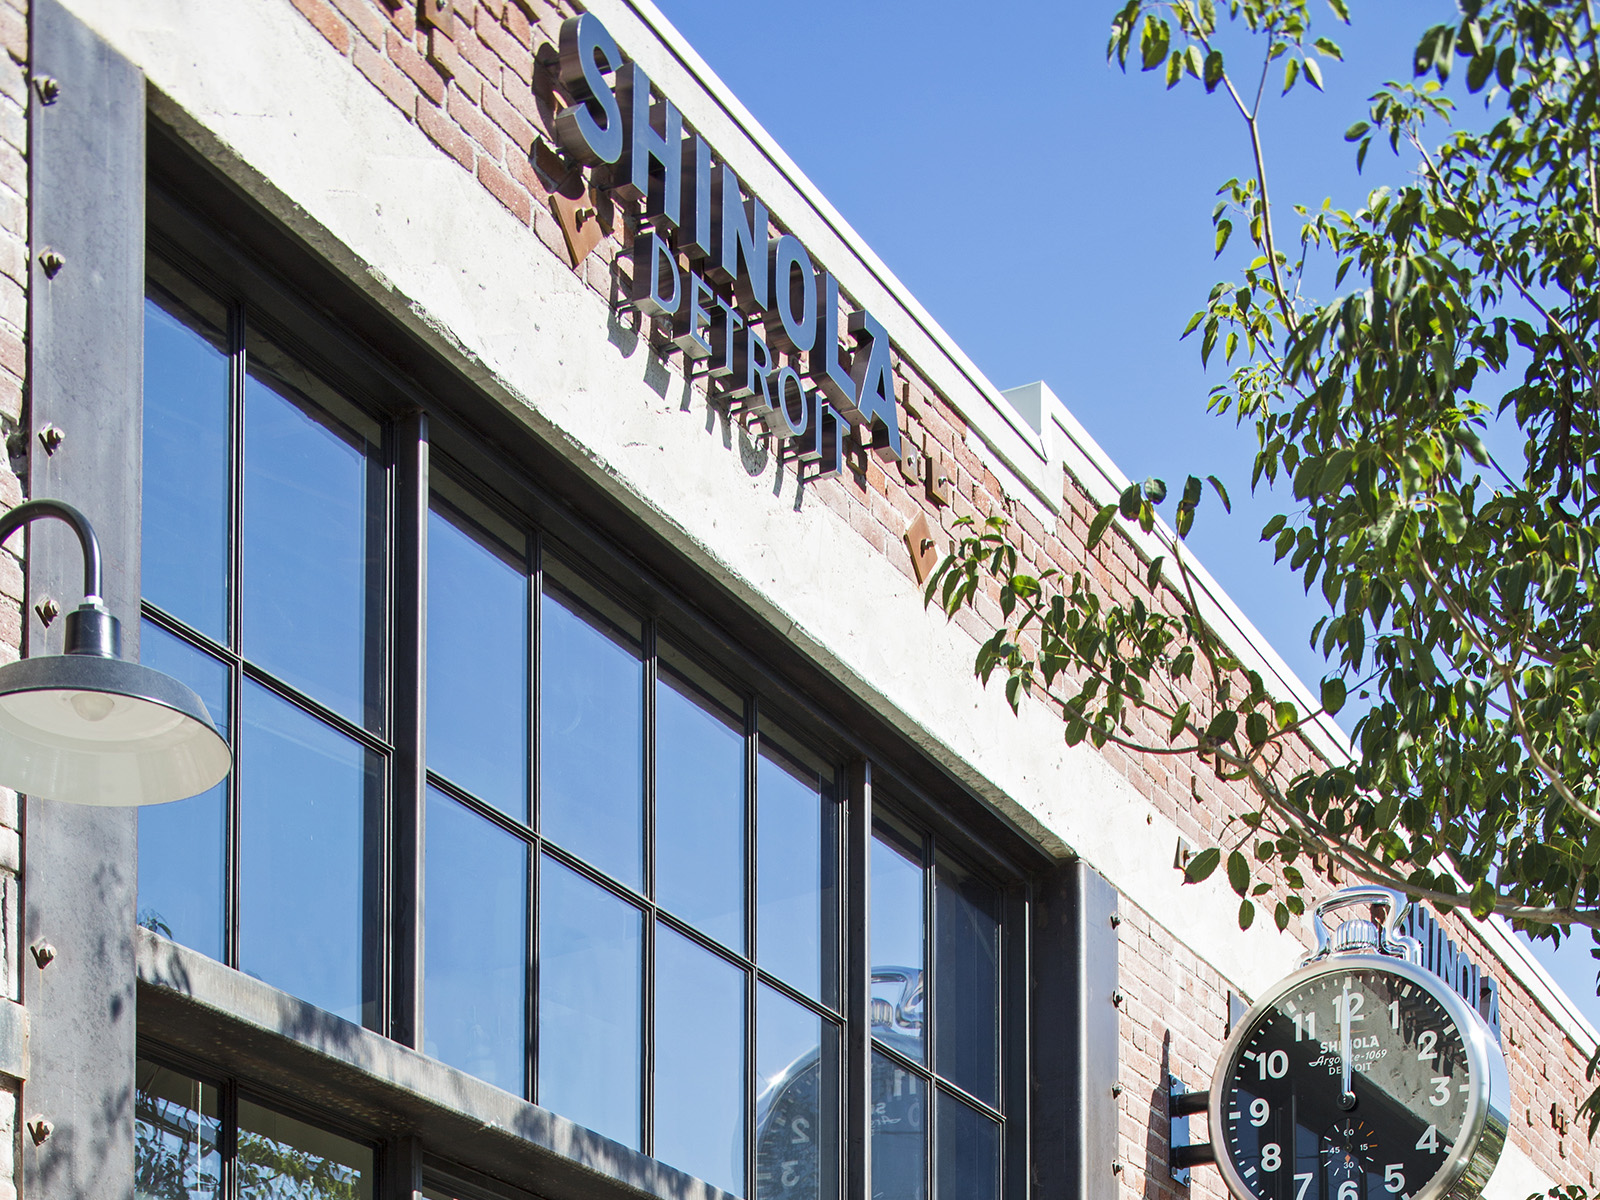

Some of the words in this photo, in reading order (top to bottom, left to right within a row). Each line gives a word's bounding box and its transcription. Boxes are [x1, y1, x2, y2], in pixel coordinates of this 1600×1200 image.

[556, 11, 901, 462] SHINOLA
[634, 232, 850, 477] DETROIT
[1332, 992, 1365, 1024] 12
[1388, 1000, 1399, 1030] 1
[1292, 1011, 1316, 1042] 11
[1418, 1030, 1438, 1061] 2
[1256, 1049, 1289, 1080] 10
[1428, 1076, 1450, 1107] 3
[1249, 1098, 1270, 1127] 9
[1330, 1146, 1340, 1154] 45
[1360, 1143, 1369, 1151] 15
[1415, 1125, 1439, 1154] 4
[1261, 1143, 1282, 1172] 8
[1343, 1161, 1354, 1169] 30
[1384, 1163, 1406, 1194] 5
